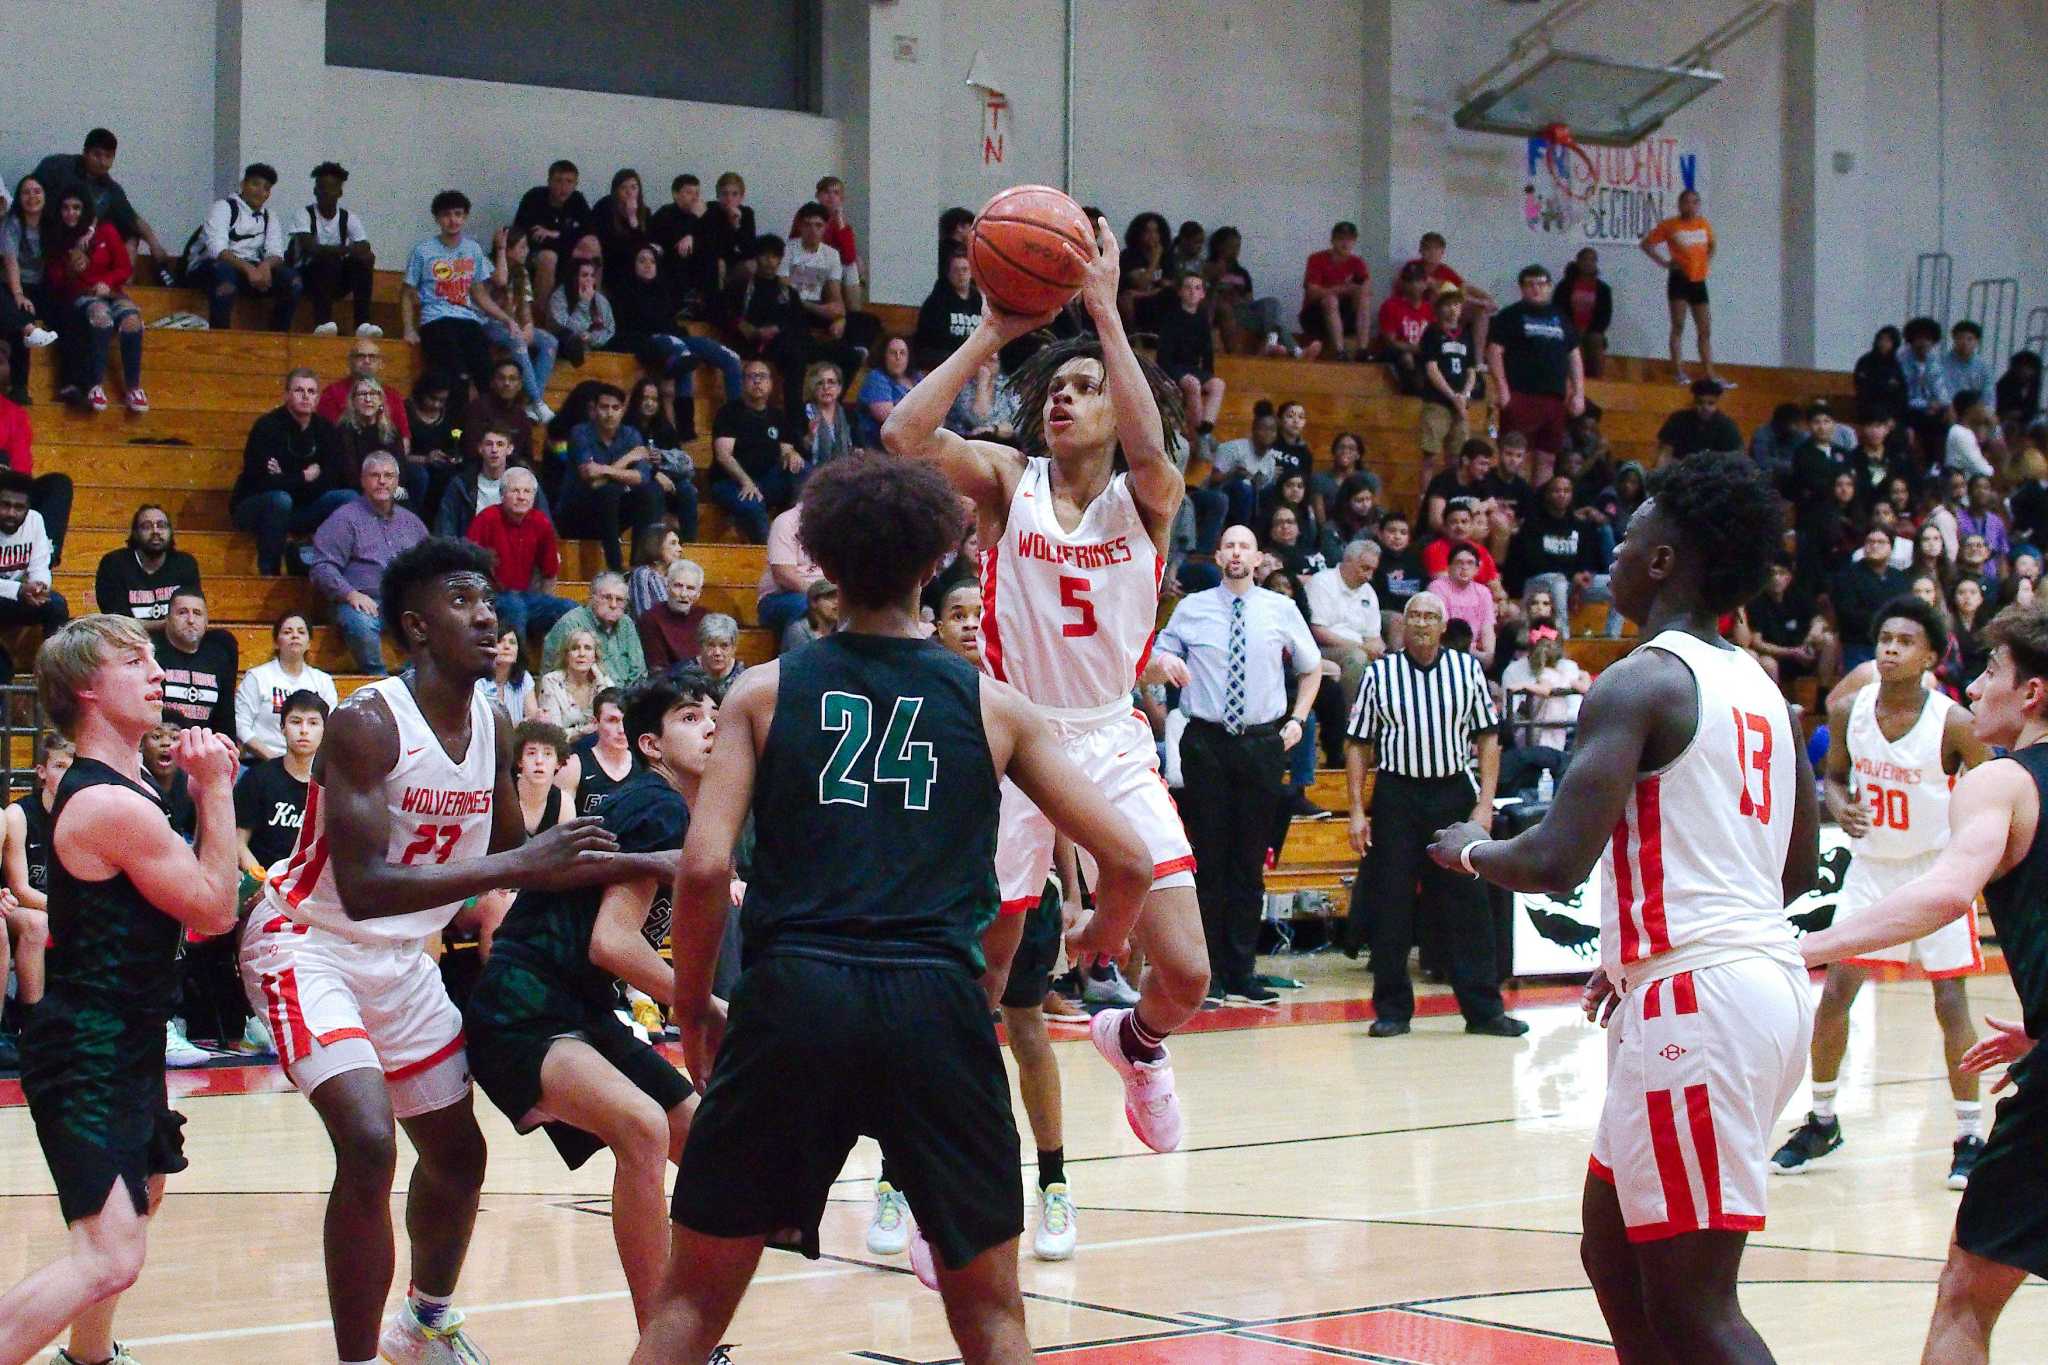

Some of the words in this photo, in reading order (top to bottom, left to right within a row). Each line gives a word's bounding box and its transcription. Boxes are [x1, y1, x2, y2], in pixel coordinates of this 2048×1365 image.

[1018, 529, 1132, 570] WOLVERINES
[1058, 575, 1098, 638] 5
[819, 690, 938, 811] 24
[1731, 706, 1773, 826] 13
[401, 786, 493, 817] WOLVERINES
[1866, 783, 1910, 831] 30
